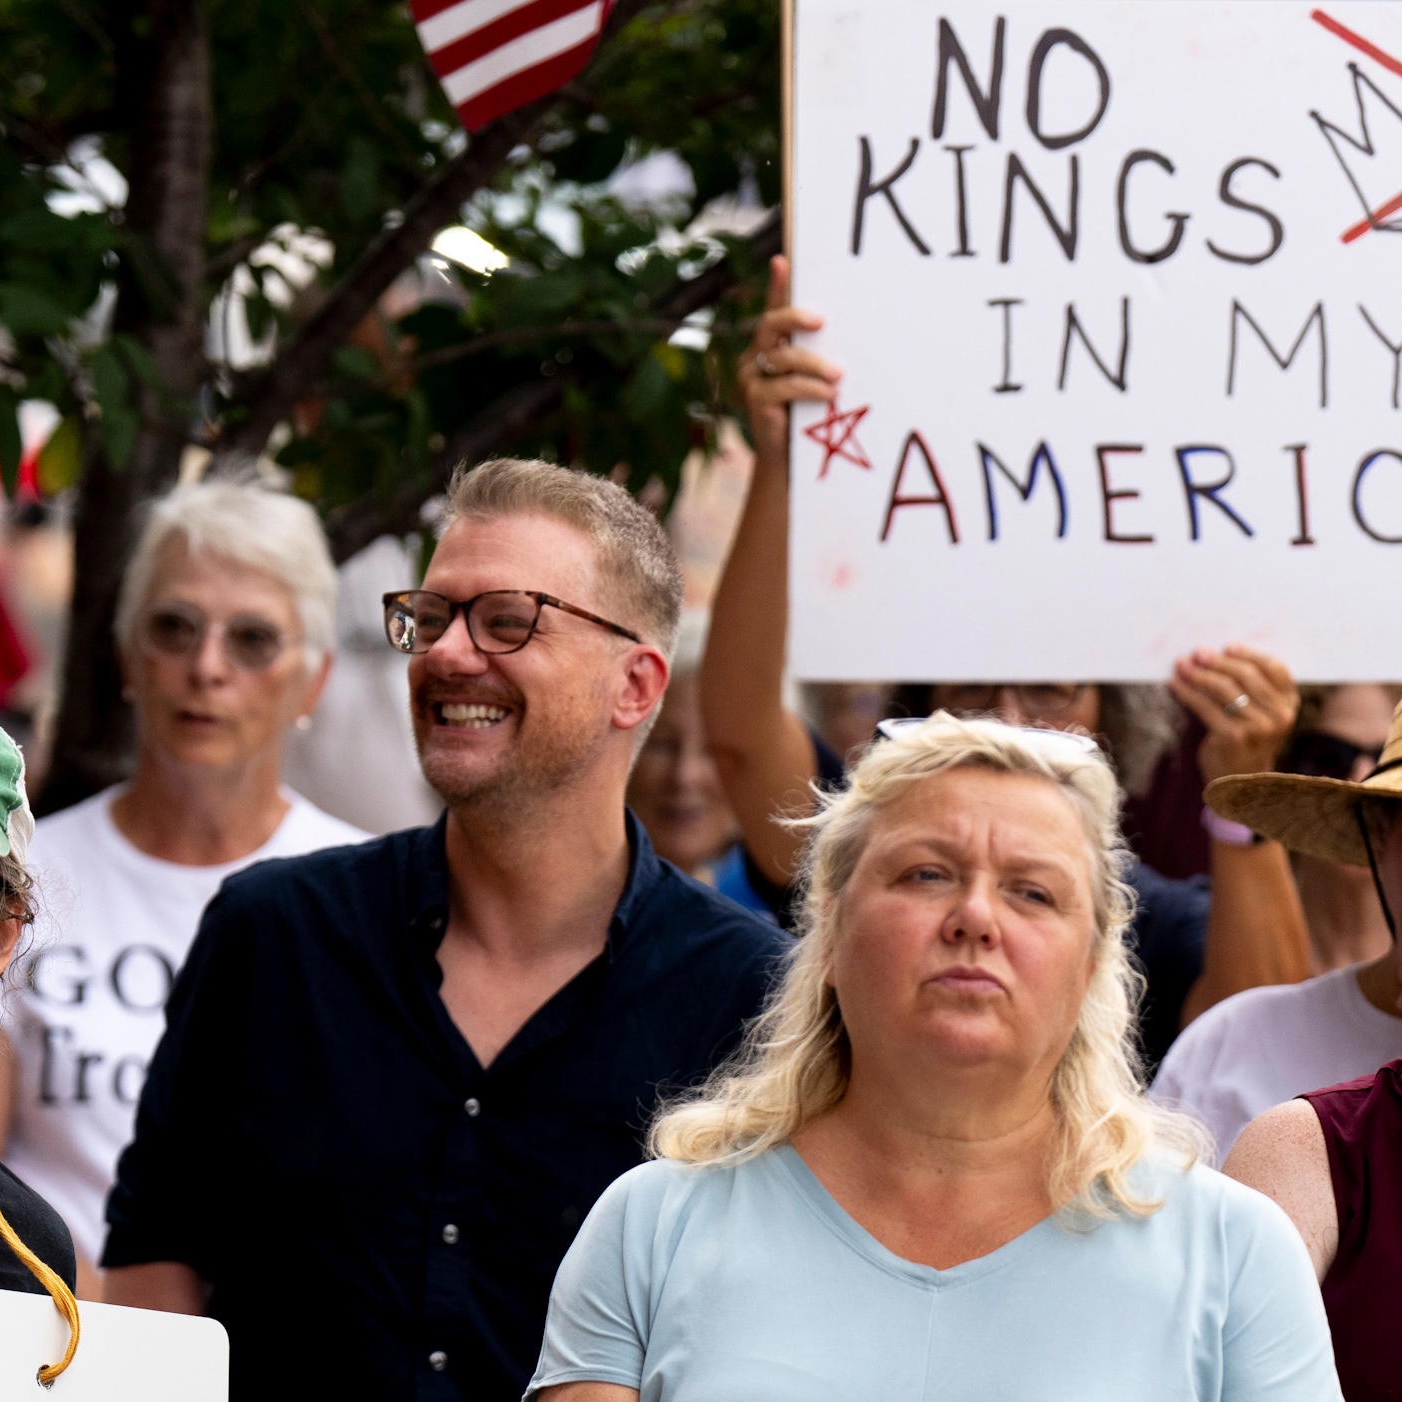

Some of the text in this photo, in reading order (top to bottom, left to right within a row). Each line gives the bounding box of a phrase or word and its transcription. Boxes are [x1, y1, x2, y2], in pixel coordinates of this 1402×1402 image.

[933, 15, 1110, 150] NO
[852, 135, 1284, 265] KINGS
[987, 297, 1130, 394] IN
